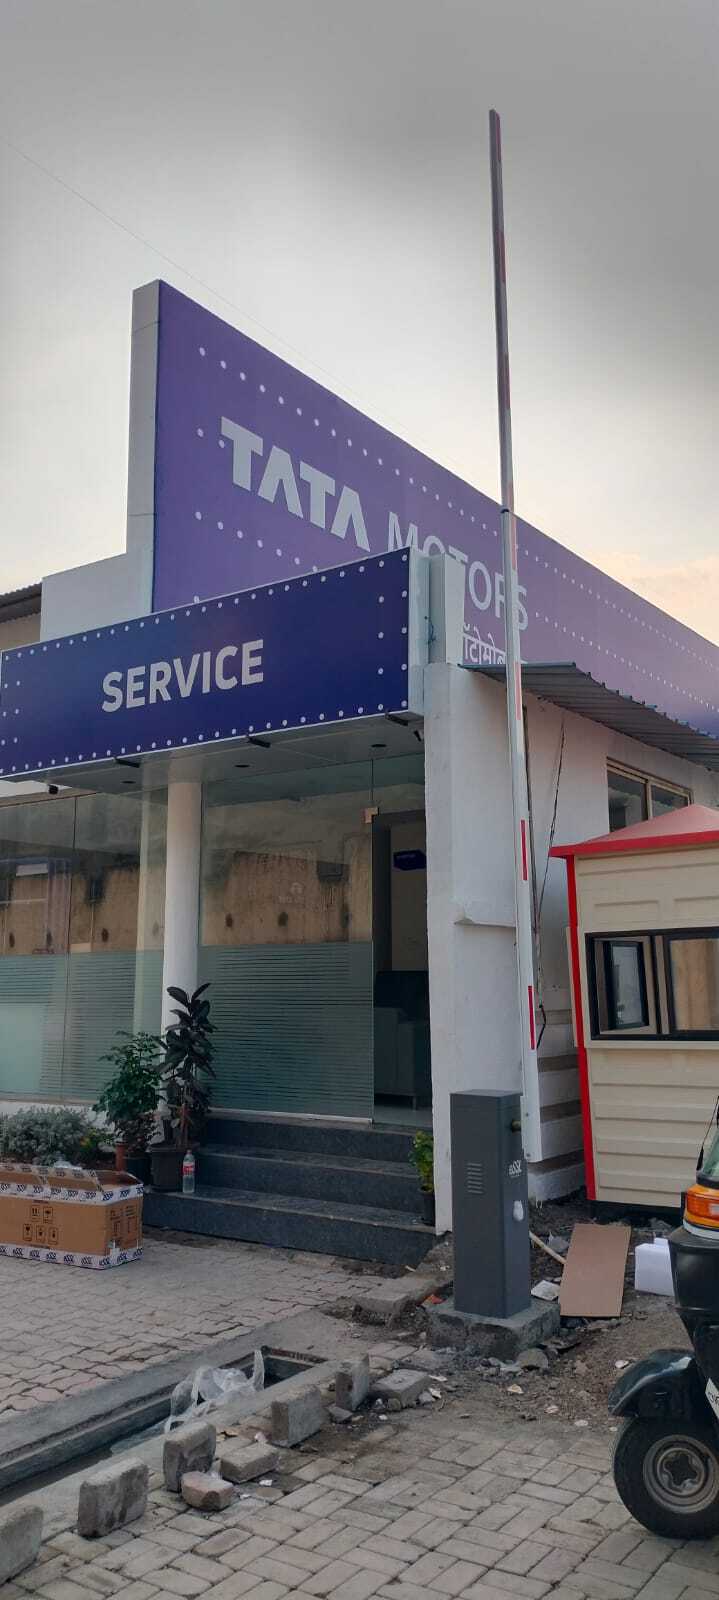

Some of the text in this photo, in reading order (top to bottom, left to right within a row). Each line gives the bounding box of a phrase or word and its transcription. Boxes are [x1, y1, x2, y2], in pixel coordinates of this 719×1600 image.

[221, 416, 529, 631] TATA MOS
[101, 639, 264, 713] SERVICE
